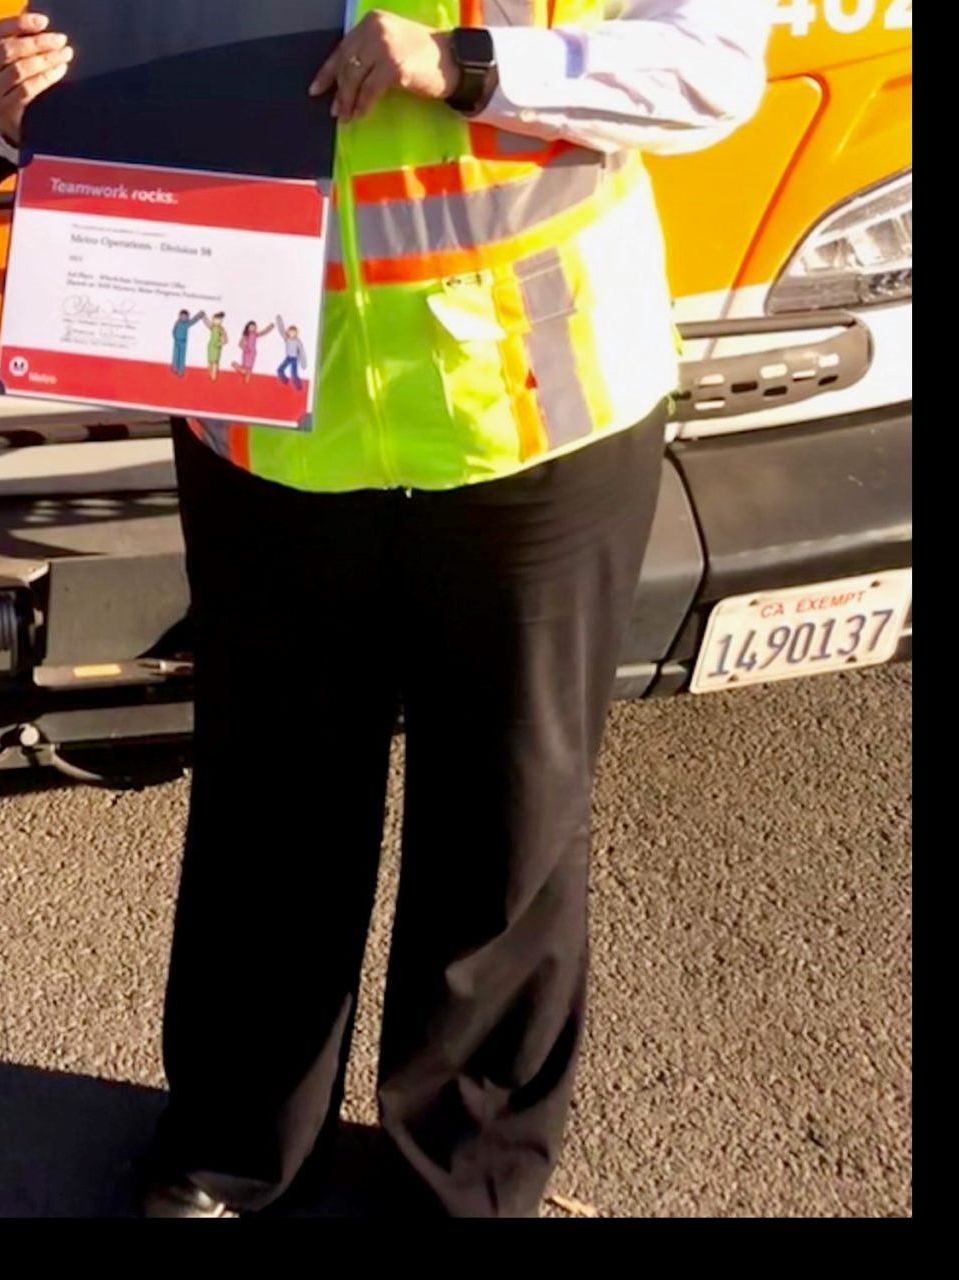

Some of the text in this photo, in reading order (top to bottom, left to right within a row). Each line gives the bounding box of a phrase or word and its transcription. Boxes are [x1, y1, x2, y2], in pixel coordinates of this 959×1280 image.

[49, 176, 179, 206] Teamwork rocks.
[70, 233, 99, 246] Metro
[100, 237, 153, 252] Operations
[160, 242, 198, 256] Division
[760, 590, 867, 619] CA EXEMPT
[706, 608, 894, 678] 1490137
